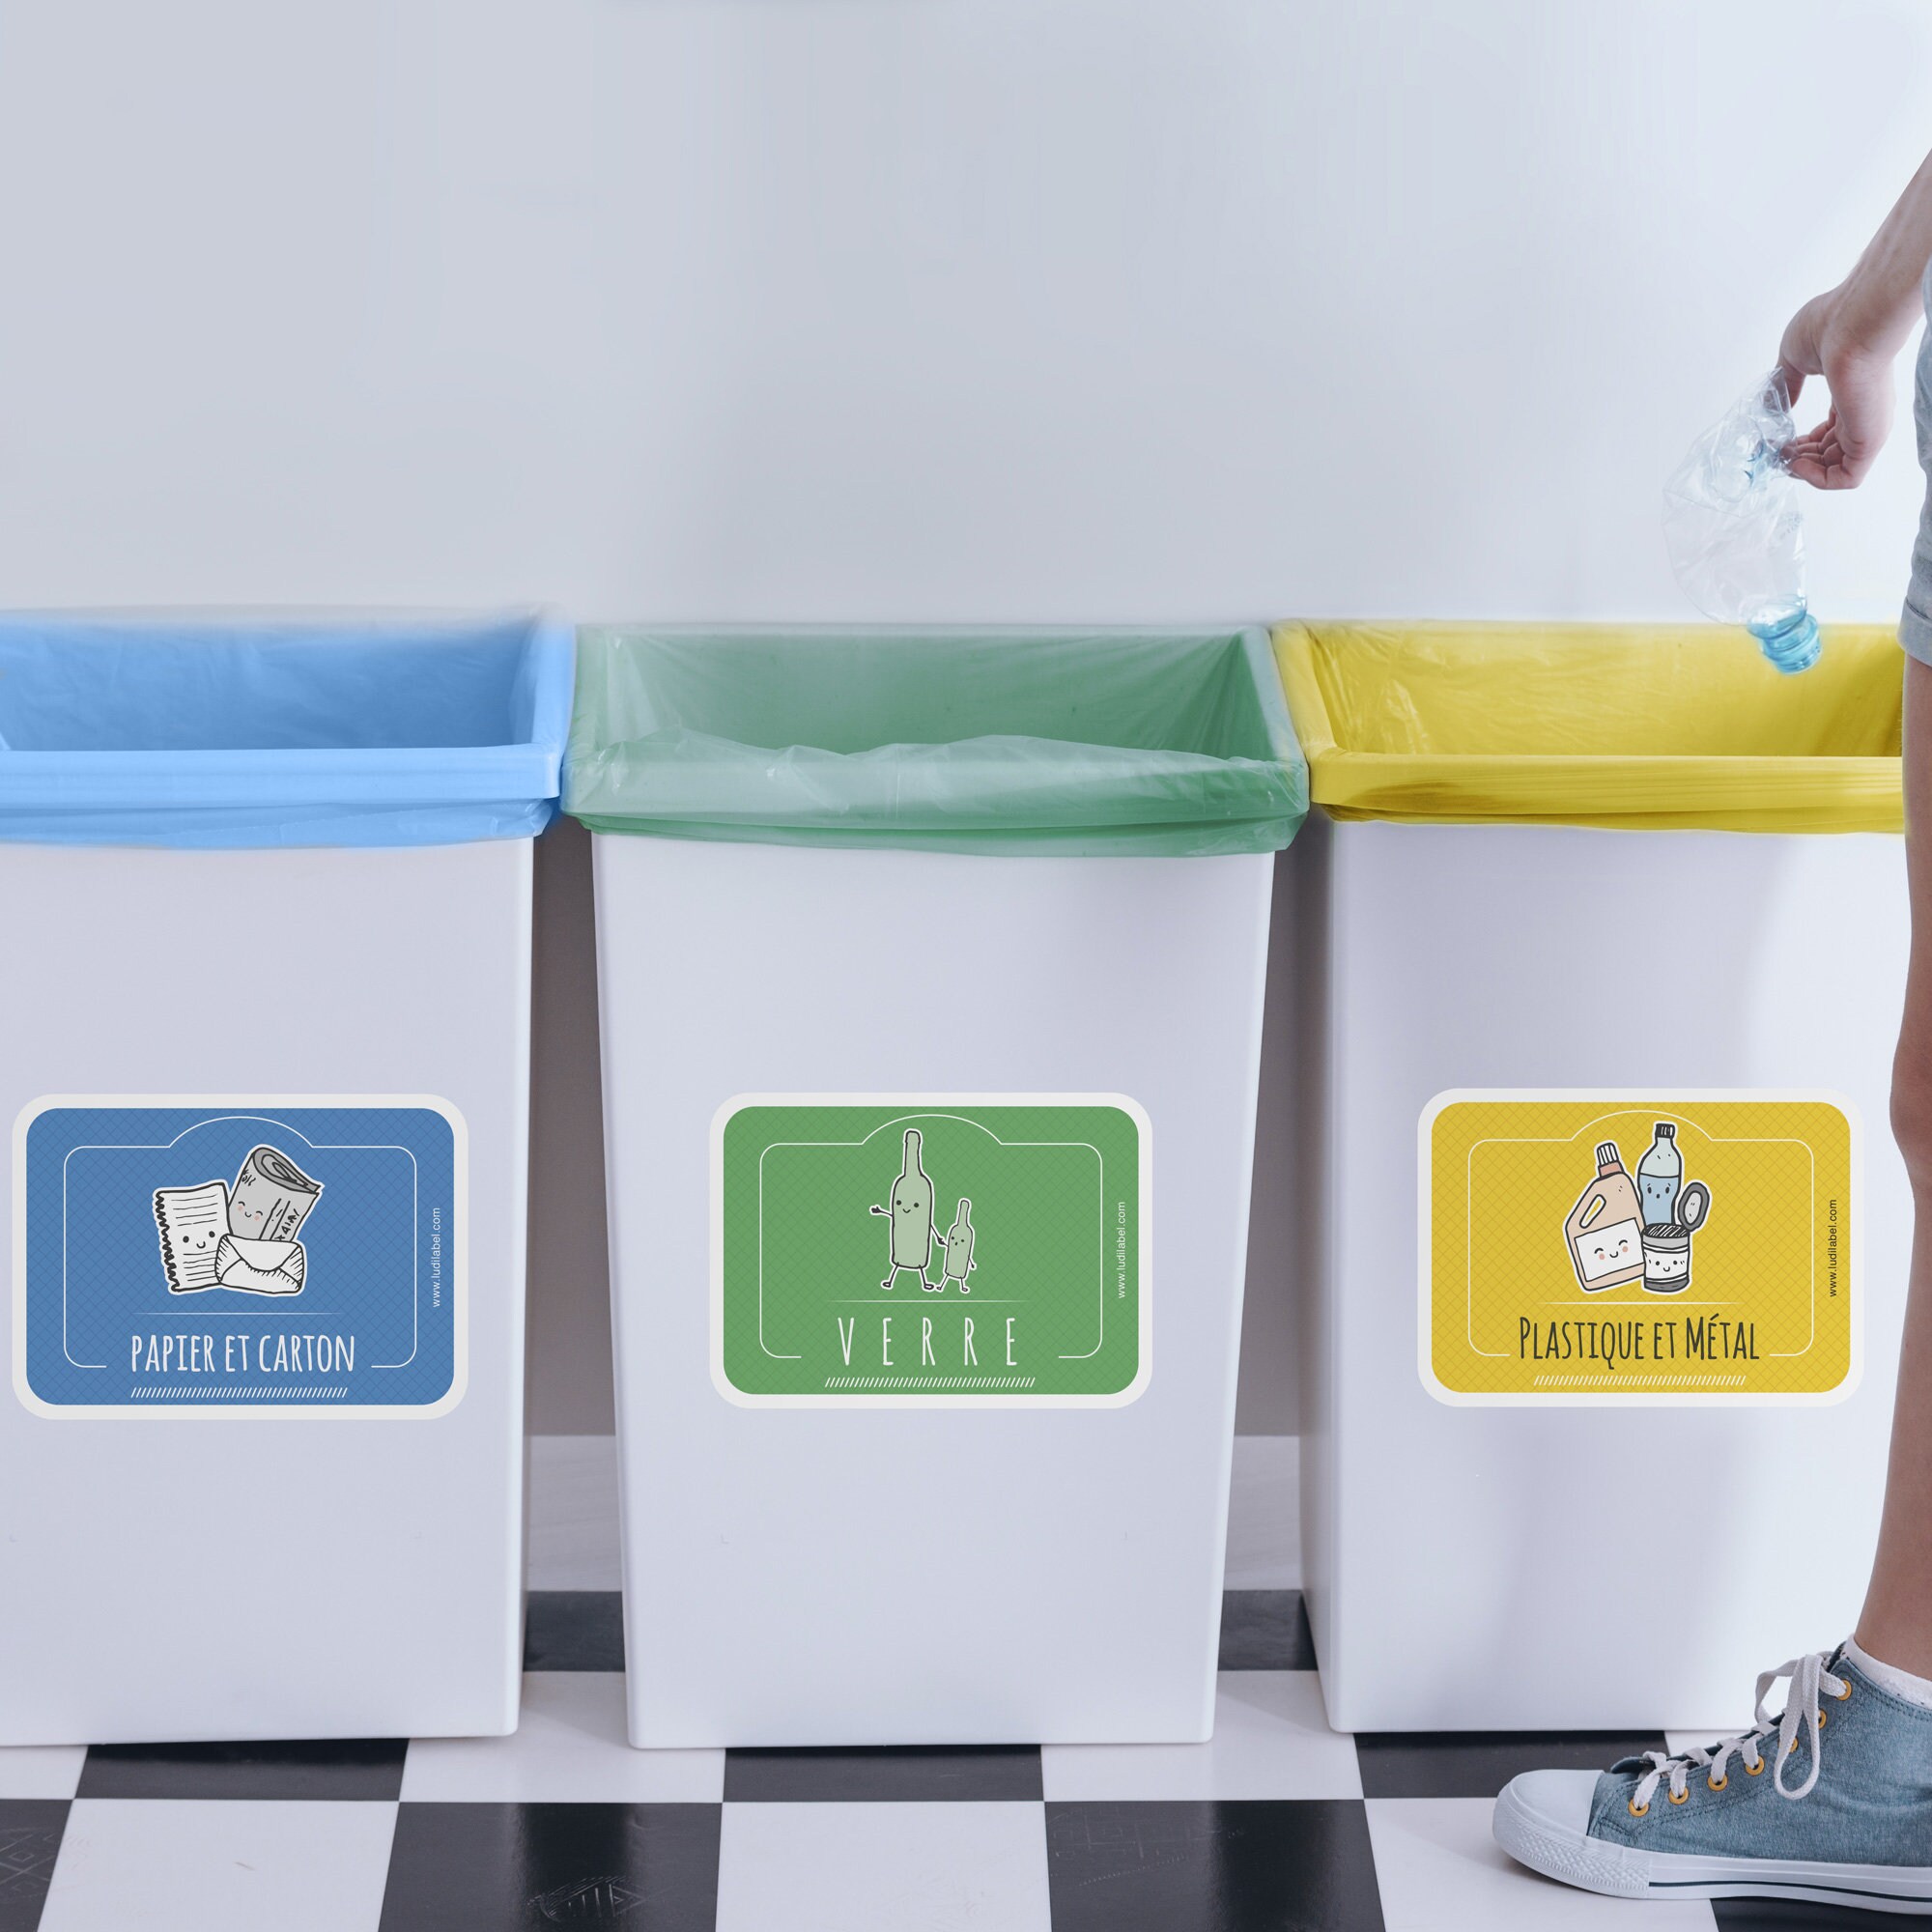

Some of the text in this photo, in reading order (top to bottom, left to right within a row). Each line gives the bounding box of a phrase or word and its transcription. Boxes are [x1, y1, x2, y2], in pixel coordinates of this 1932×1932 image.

[431, 1207, 441, 1308] www.ludilabel.com
[1116, 1201, 1126, 1299] www.ludilabel.com
[1828, 1199, 1838, 1298] www.ludilabel.com
[131, 1335, 355, 1373] PAPIER ET CARTON
[837, 1317, 1017, 1366] VERRE
[1520, 1313, 1760, 1370] PLASTIQUE ET MÉTAL
